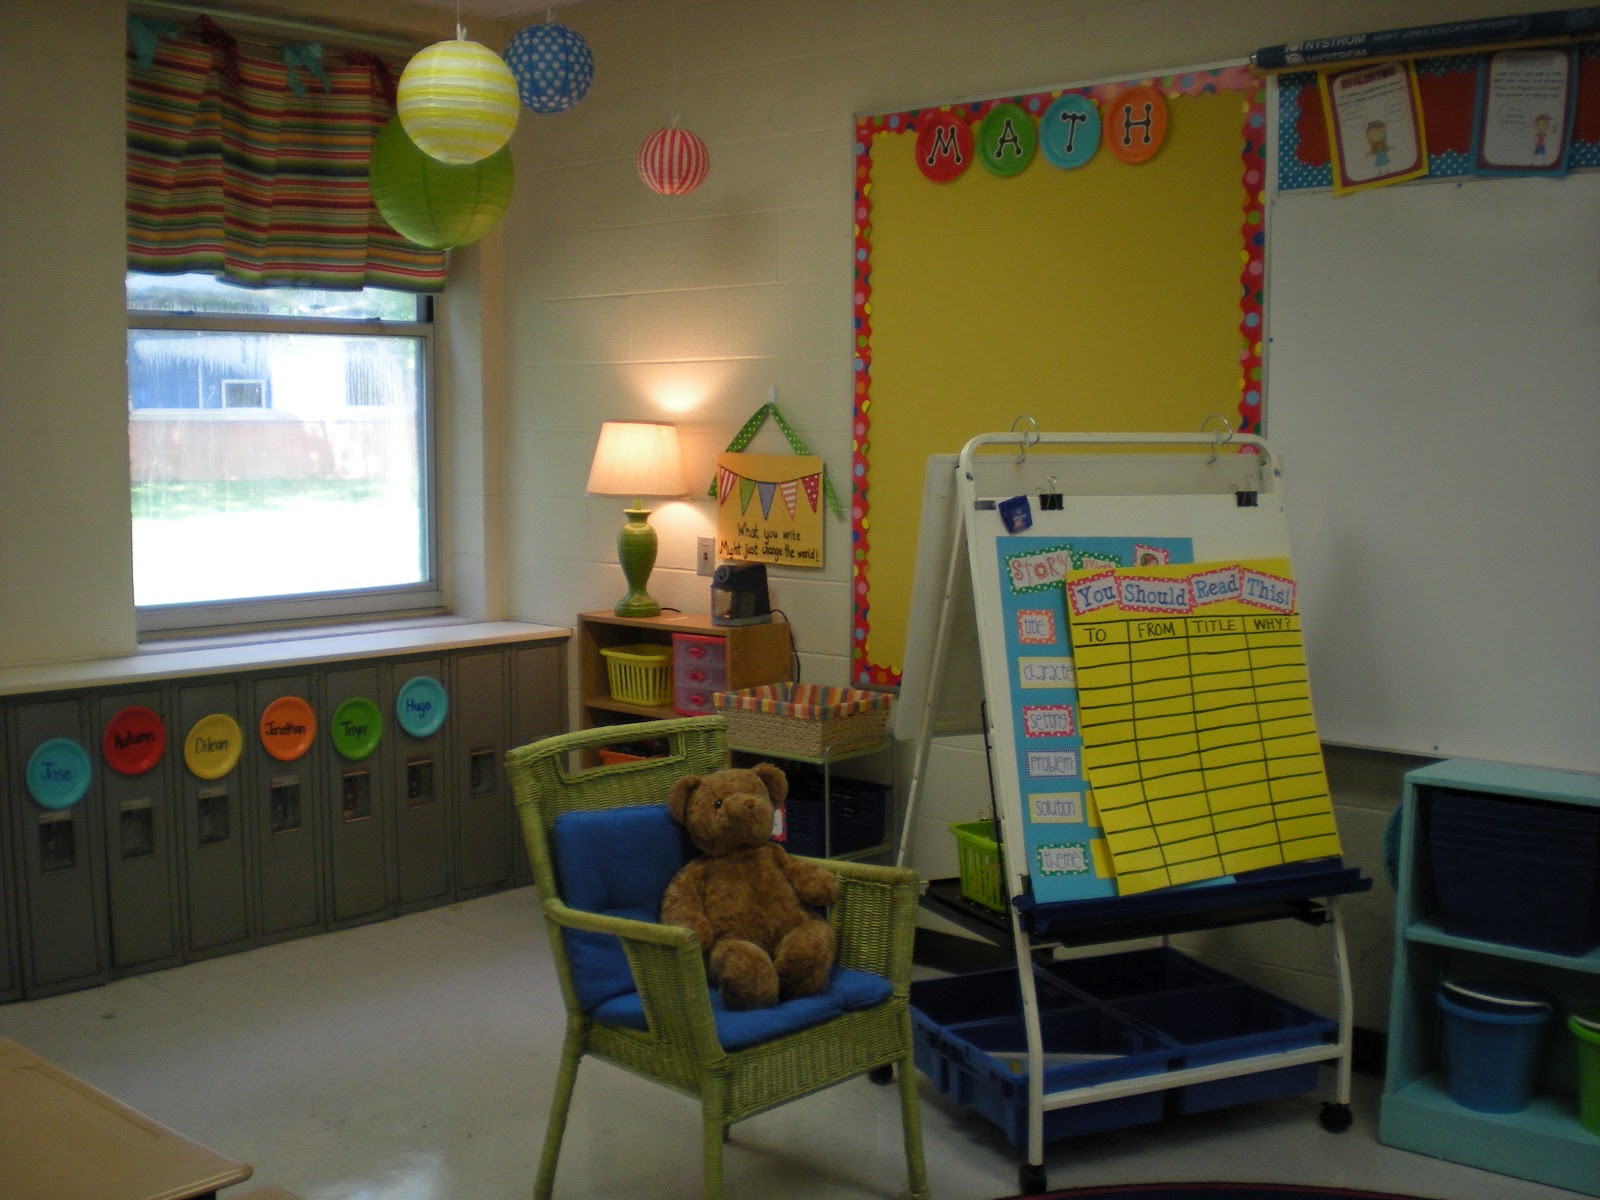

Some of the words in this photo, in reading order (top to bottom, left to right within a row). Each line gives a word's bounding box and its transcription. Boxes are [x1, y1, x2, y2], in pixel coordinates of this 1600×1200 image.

[1302, 33, 1366, 52] NYSTROM
[927, 102, 1153, 166] MATH
[737, 522, 759, 539] What
[764, 530, 778, 544] you
[782, 529, 801, 541] write
[719, 541, 741, 560] Might
[743, 544, 758, 558] just
[762, 545, 783, 562] change
[784, 545, 796, 558] the
[1077, 584, 1117, 608] You
[1123, 583, 1188, 607] Should
[1193, 574, 1239, 598] Read
[1246, 577, 1291, 606] This!
[1083, 627, 1107, 643] TO
[1138, 621, 1176, 639] FROM
[1192, 618, 1237, 633] TITLE
[1253, 617, 1292, 631] WHY?
[1023, 663, 1076, 682] characte
[406, 698, 432, 718] Hugo
[40, 761, 72, 782] Jose
